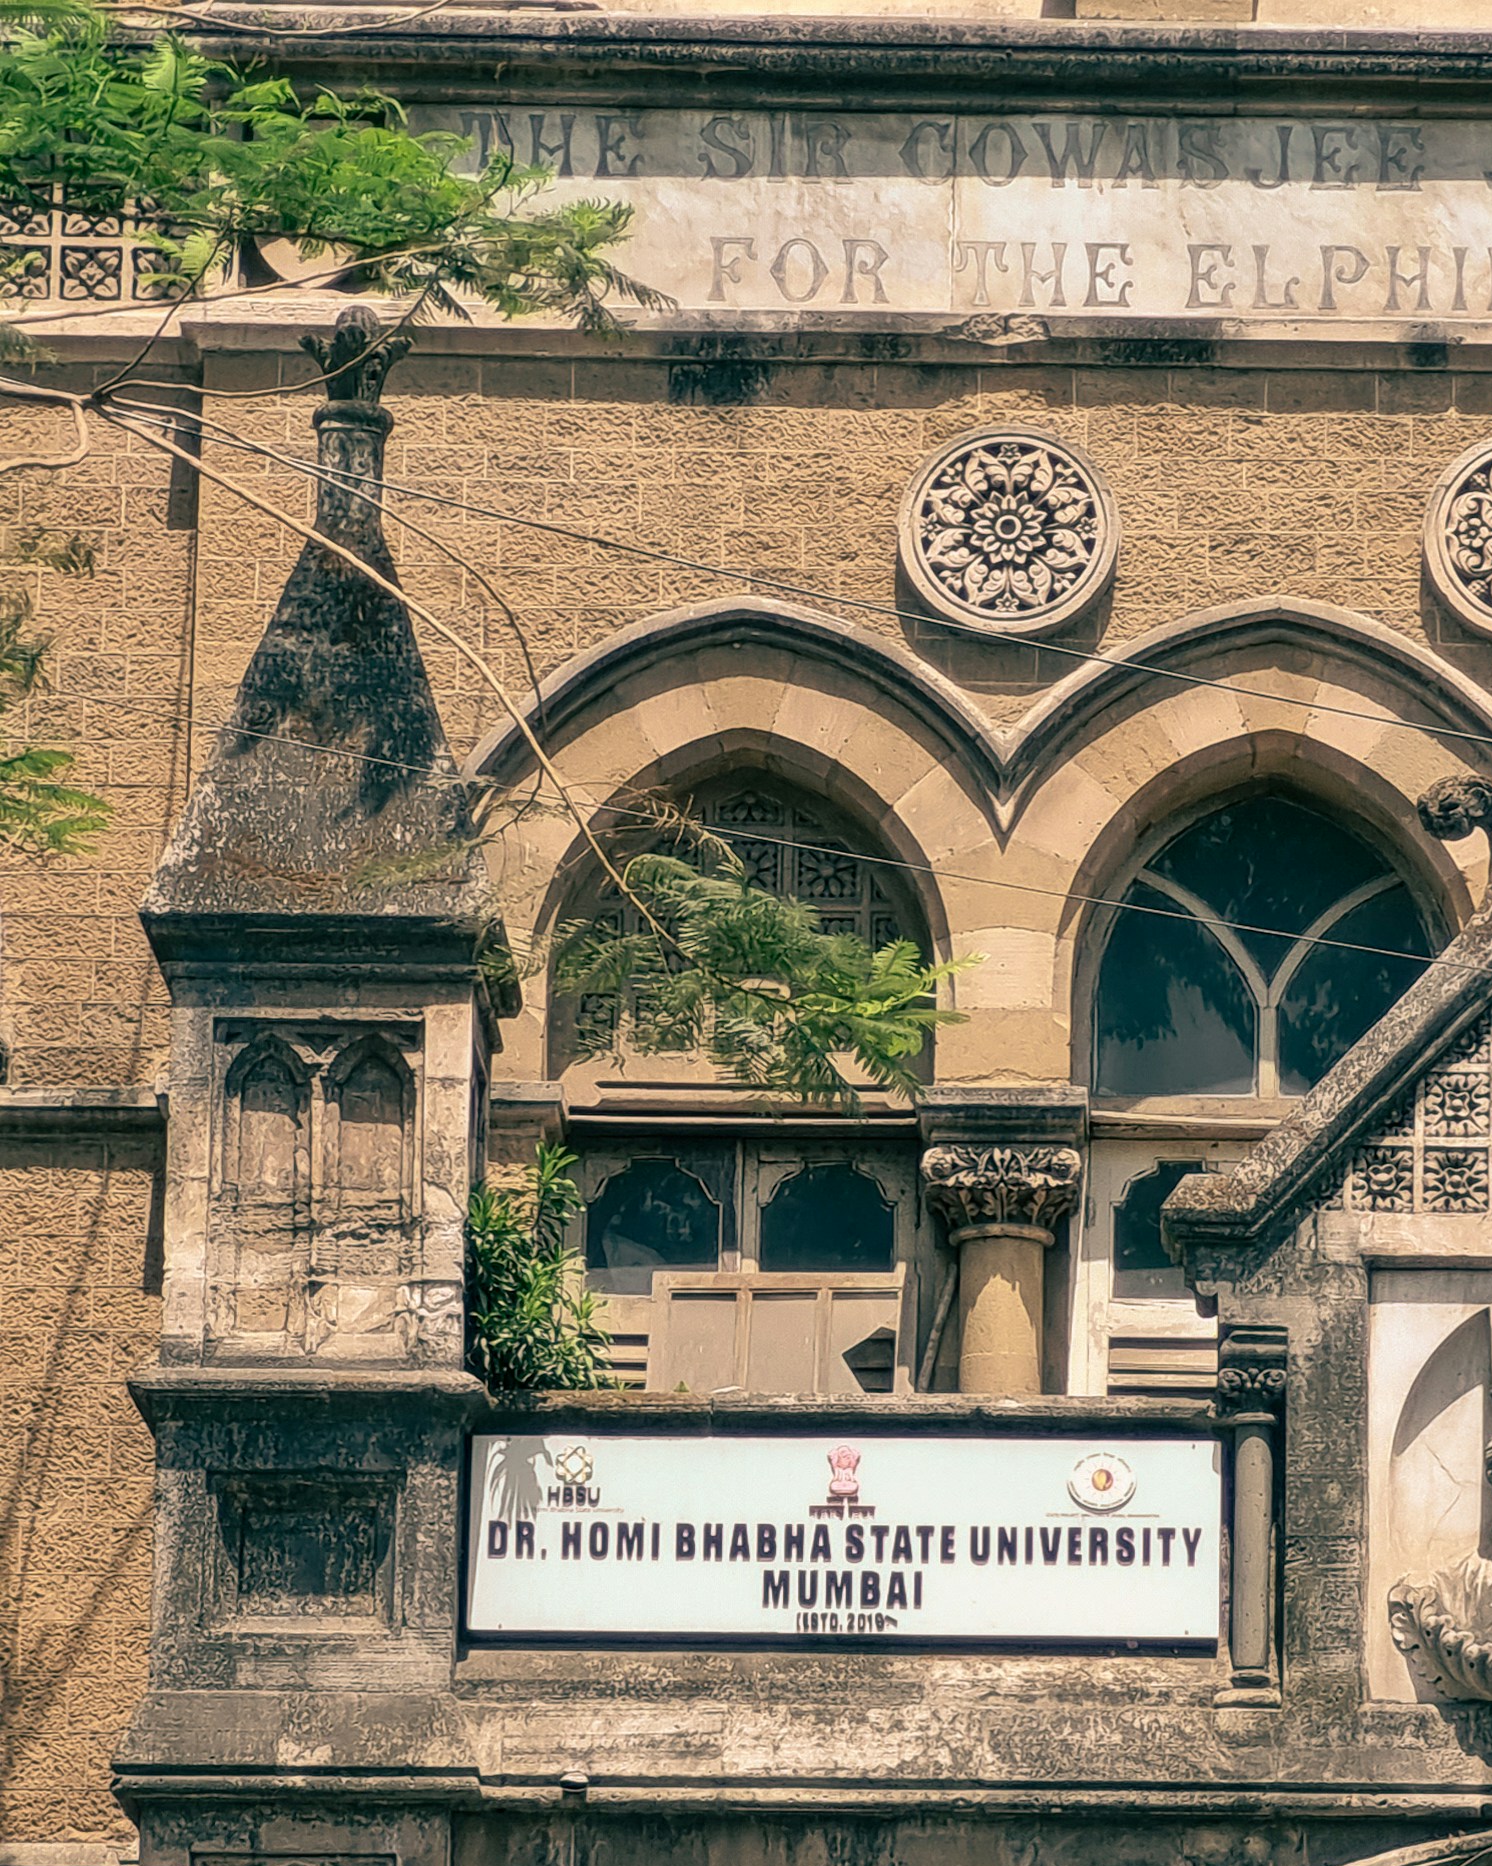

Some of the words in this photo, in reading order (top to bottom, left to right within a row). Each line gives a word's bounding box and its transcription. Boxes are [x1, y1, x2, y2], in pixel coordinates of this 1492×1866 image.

[460, 110, 645, 178] THE
[696, 115, 854, 186] SIR
[897, 120, 1425, 192] COWASJEE
[706, 236, 891, 304] FOR
[954, 241, 1134, 308] THE
[546, 1486, 601, 1508] HBSU
[487, 1519, 547, 1560] DR.
[561, 1520, 661, 1561] HOMI
[675, 1522, 833, 1563] BHABHA
[845, 1523, 956, 1564] STATE
[970, 1525, 1203, 1567] UNIVERSITY
[762, 1569, 924, 1610] MUMBAI
